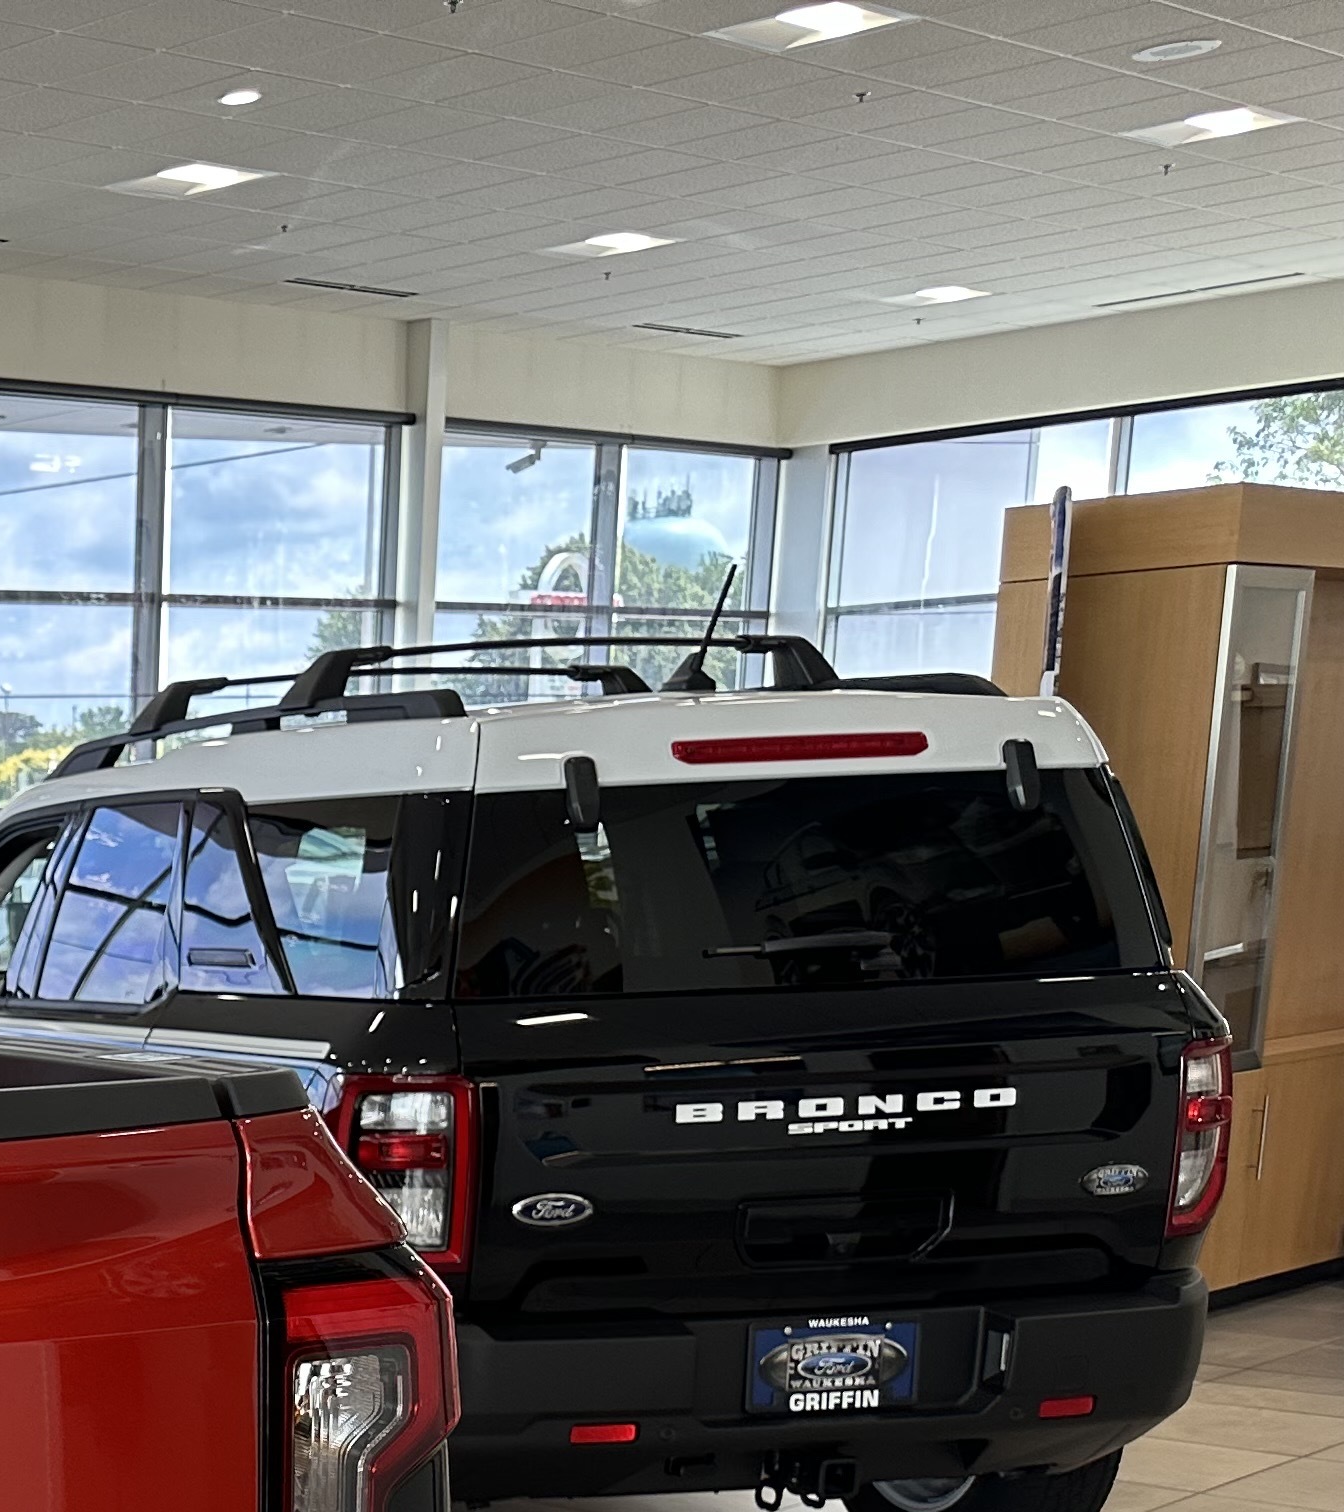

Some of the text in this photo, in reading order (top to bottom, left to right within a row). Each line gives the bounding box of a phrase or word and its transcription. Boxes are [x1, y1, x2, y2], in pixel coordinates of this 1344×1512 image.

[675, 1087, 1017, 1124] BRONCO
[787, 1117, 913, 1135] SPORT
[532, 1200, 576, 1219] Ford
[808, 1316, 870, 1329] WAUKESHA
[790, 1339, 881, 1362] GRIFFIN
[813, 1357, 855, 1375] Ford
[789, 1375, 876, 1389] WAUKESHA
[789, 1389, 880, 1412] GRIFFIN
